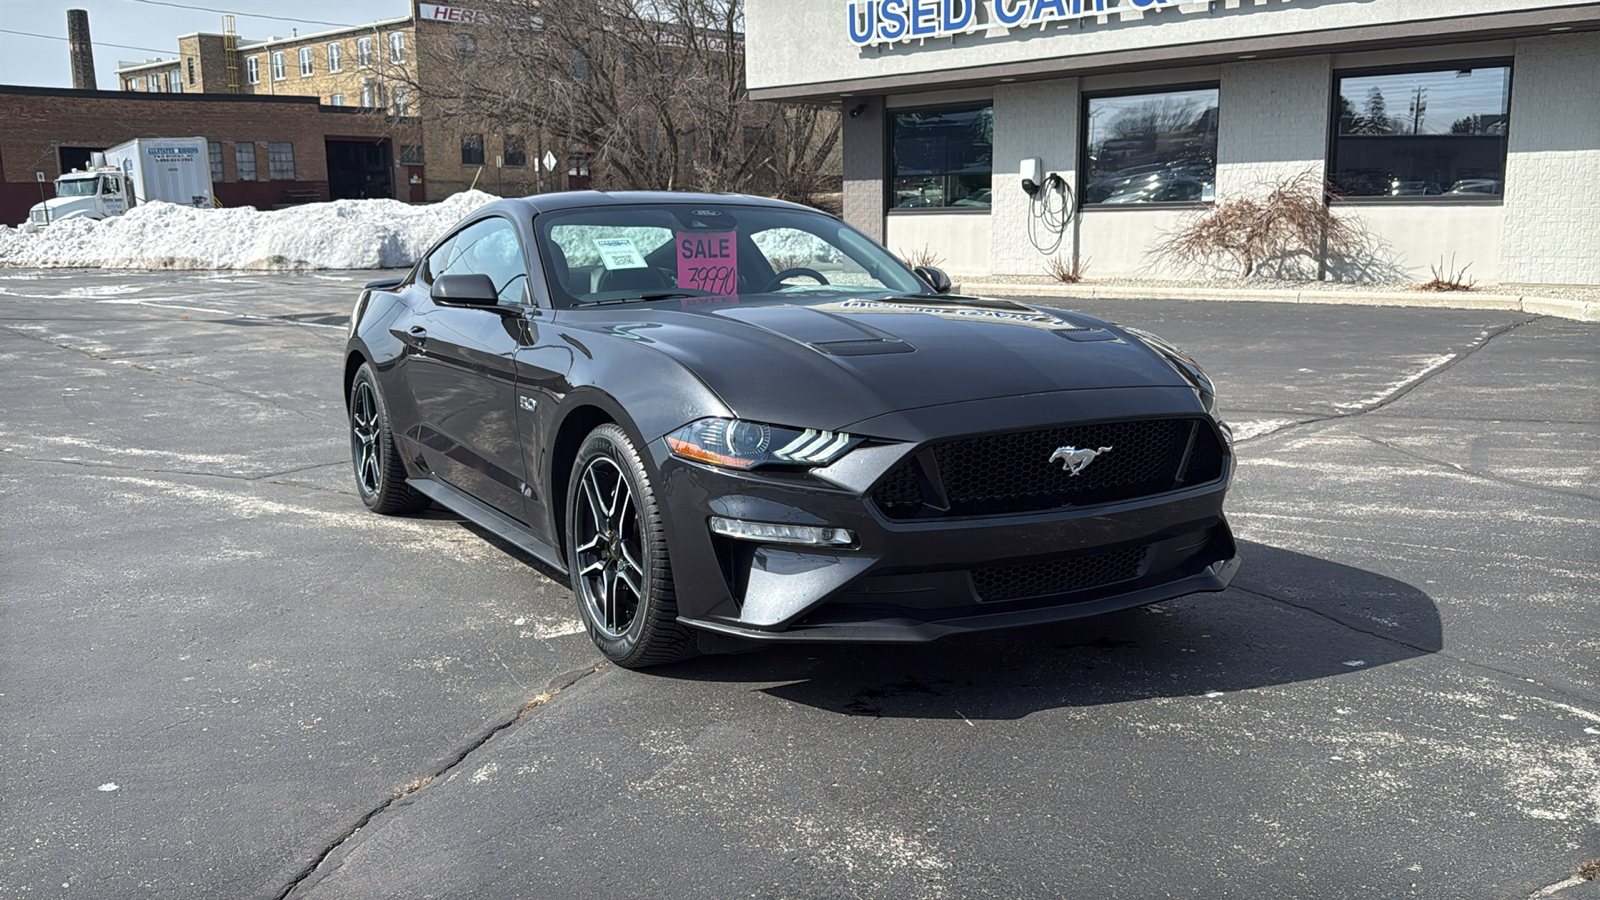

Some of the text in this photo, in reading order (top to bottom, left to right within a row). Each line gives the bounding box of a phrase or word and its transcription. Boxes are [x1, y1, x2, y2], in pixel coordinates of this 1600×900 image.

[847, 0, 973, 44] USED
[681, 239, 731, 259] SALE
[688, 266, 736, 295] 39990
